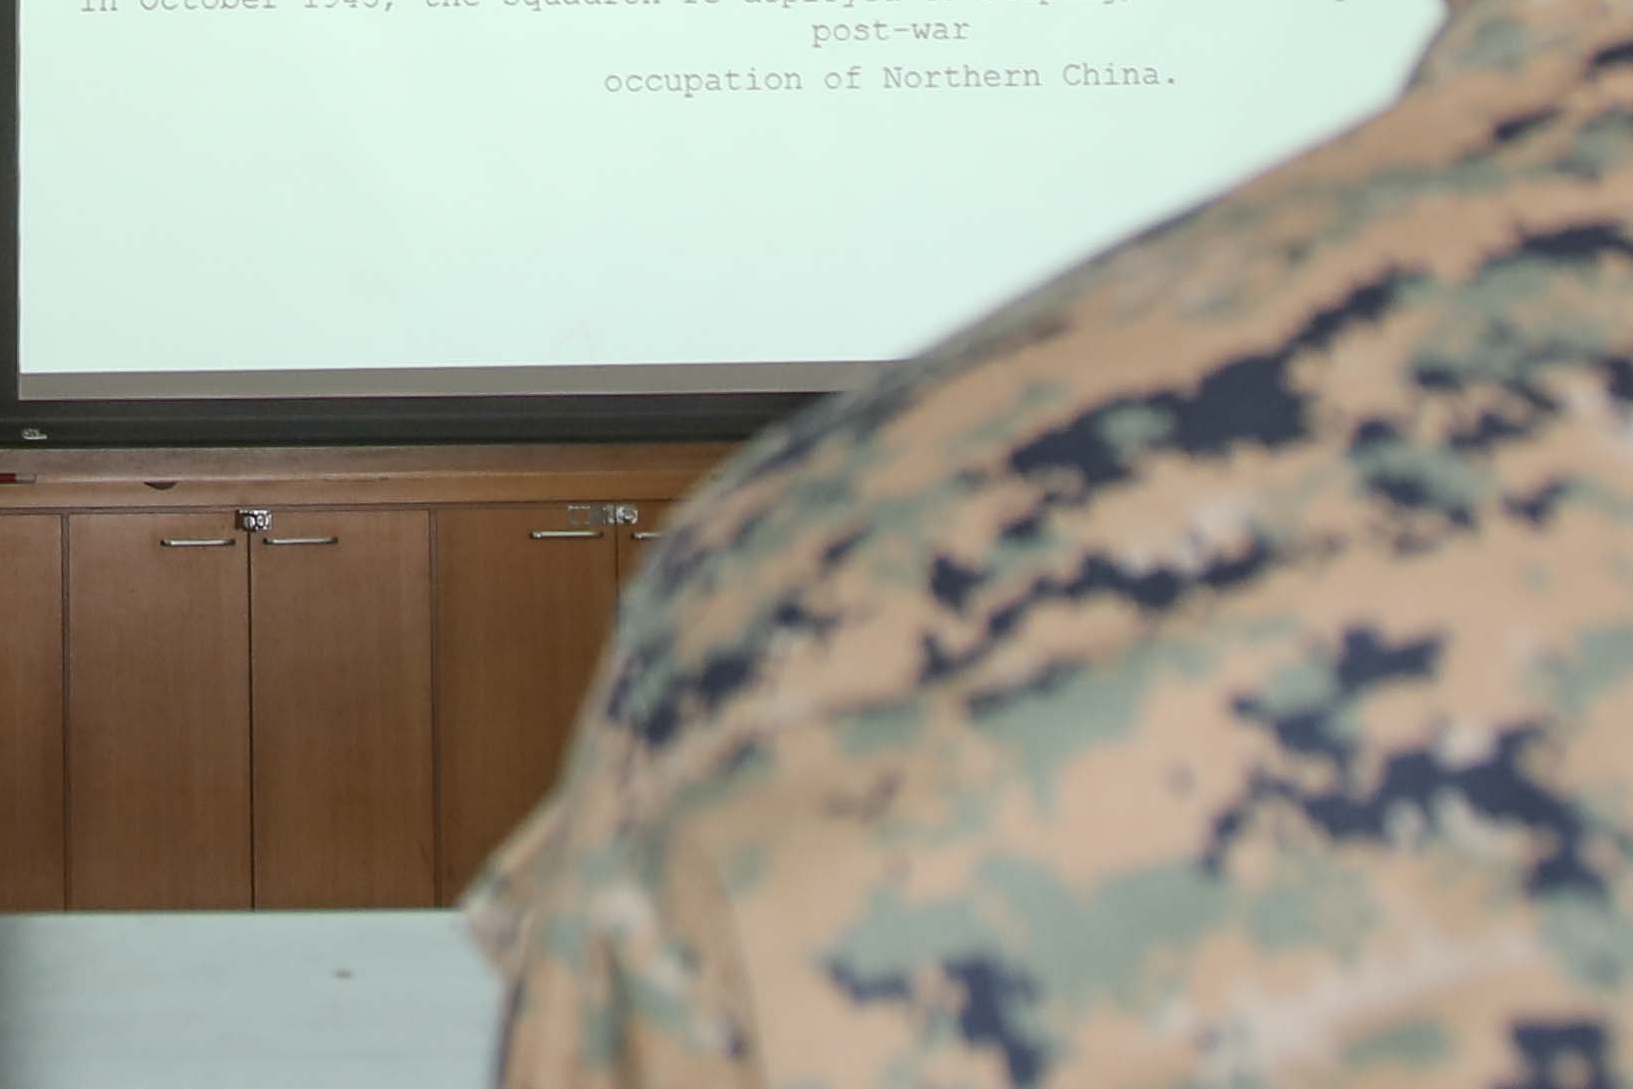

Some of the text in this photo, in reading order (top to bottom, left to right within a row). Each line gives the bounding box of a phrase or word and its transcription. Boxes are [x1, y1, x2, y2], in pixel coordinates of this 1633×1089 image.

[811, 19, 970, 49] post-war
[604, 63, 1174, 98] occupation of Northern China.
